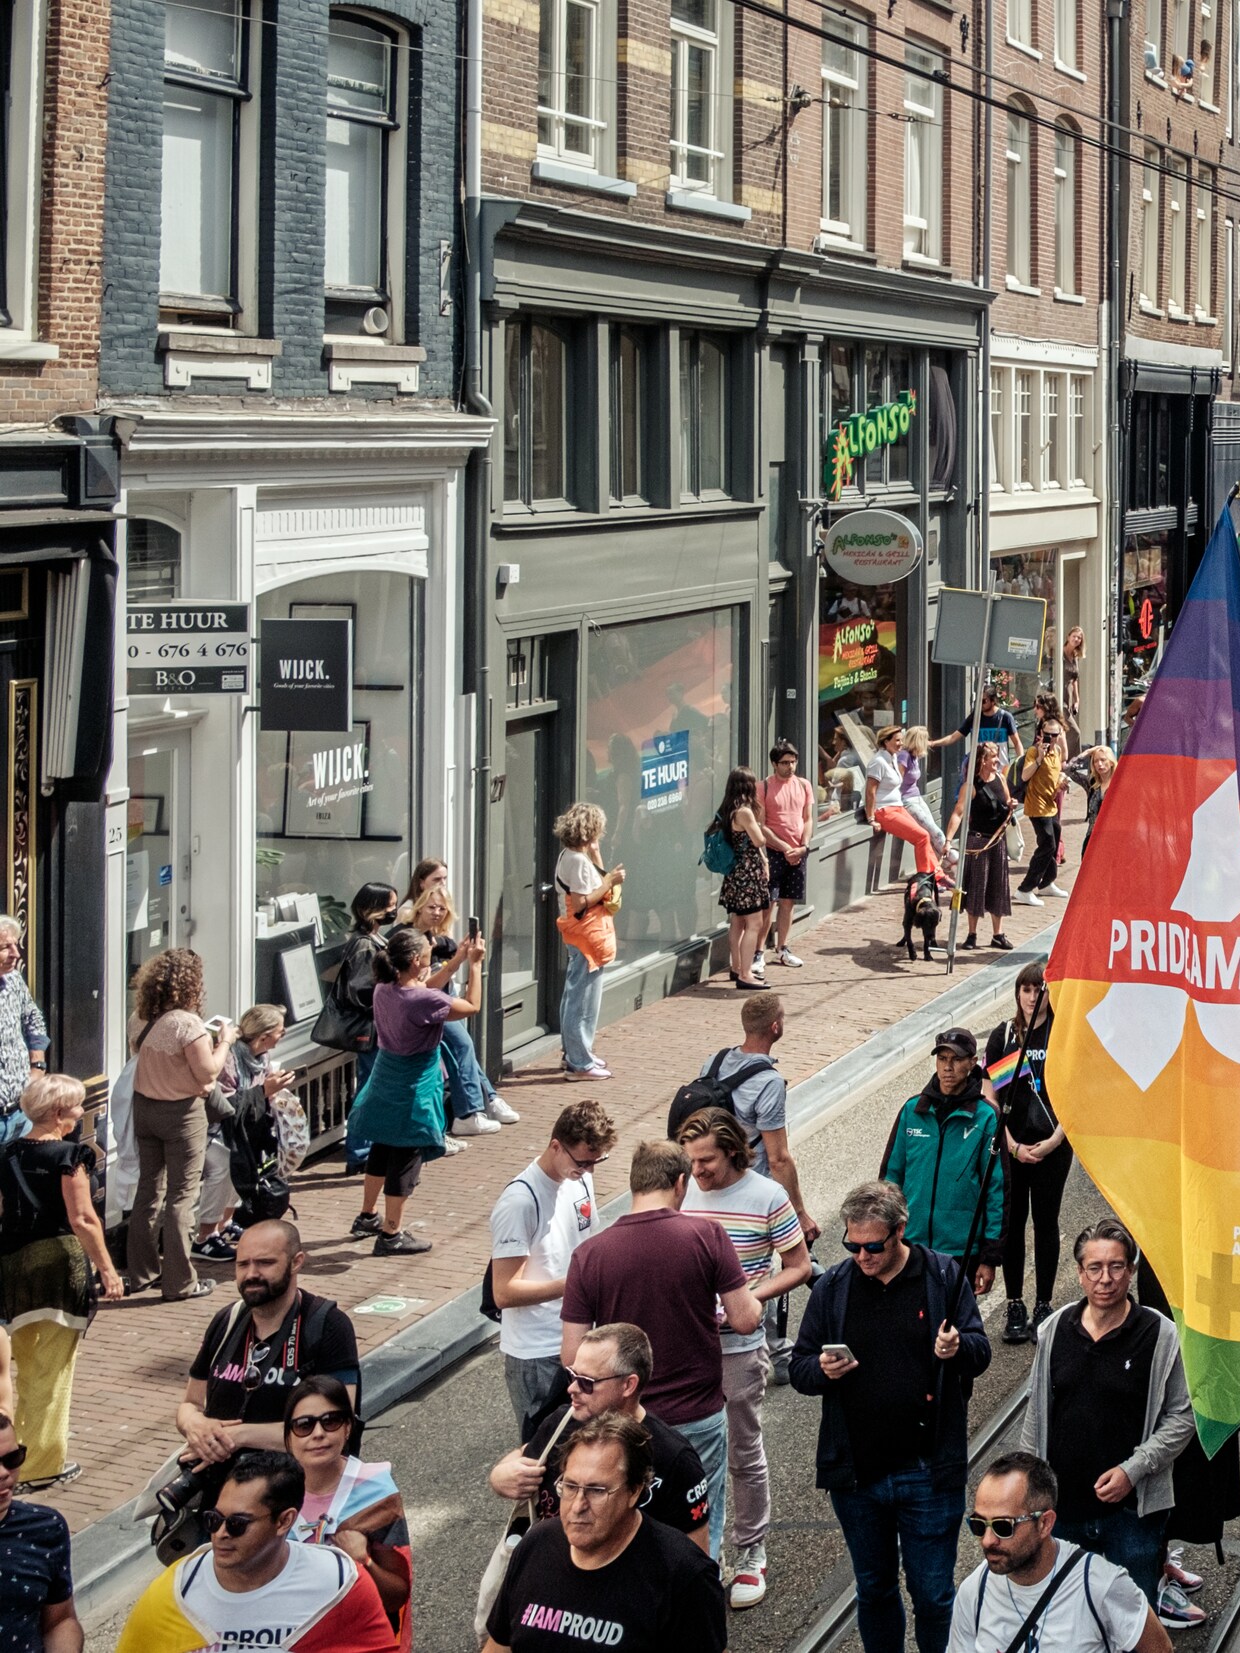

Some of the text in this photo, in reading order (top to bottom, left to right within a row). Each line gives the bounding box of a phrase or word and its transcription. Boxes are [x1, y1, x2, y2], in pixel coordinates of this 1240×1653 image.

[127, 612, 229, 629] TE HUUR
[158, 643, 190, 658] 676
[197, 643, 208, 657] 4
[215, 642, 248, 657] 676
[156, 669, 196, 686] B&O
[279, 659, 330, 680] WIJCK.
[854, 673, 860, 684] &
[312, 743, 369, 790] WIJCK.
[642, 760, 688, 790] TE HUUR
[306, 797, 317, 808] Art
[325, 793, 338, 806] your
[108, 826, 123, 844] 25
[287, 1347, 295, 1367] EOS
[520, 1603, 624, 1646] #IAMPROUD
